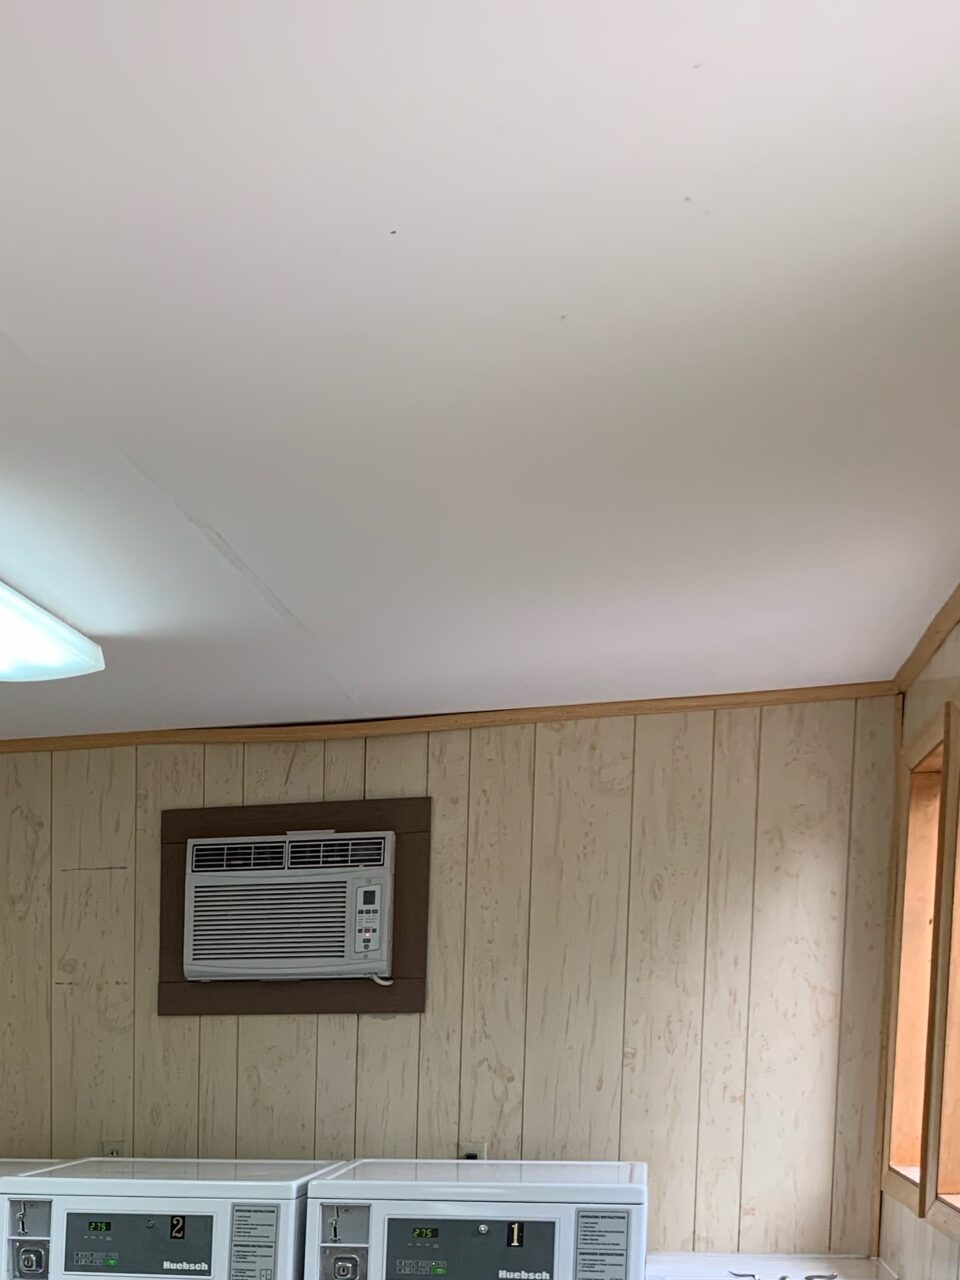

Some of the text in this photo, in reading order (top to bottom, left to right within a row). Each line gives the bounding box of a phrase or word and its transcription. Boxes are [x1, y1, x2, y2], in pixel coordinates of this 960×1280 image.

[172, 1216, 184, 1238] 2
[510, 1222, 520, 1246] 1
[162, 1260, 209, 1271] Huebsch
[498, 1269, 550, 1280] Huebsch
